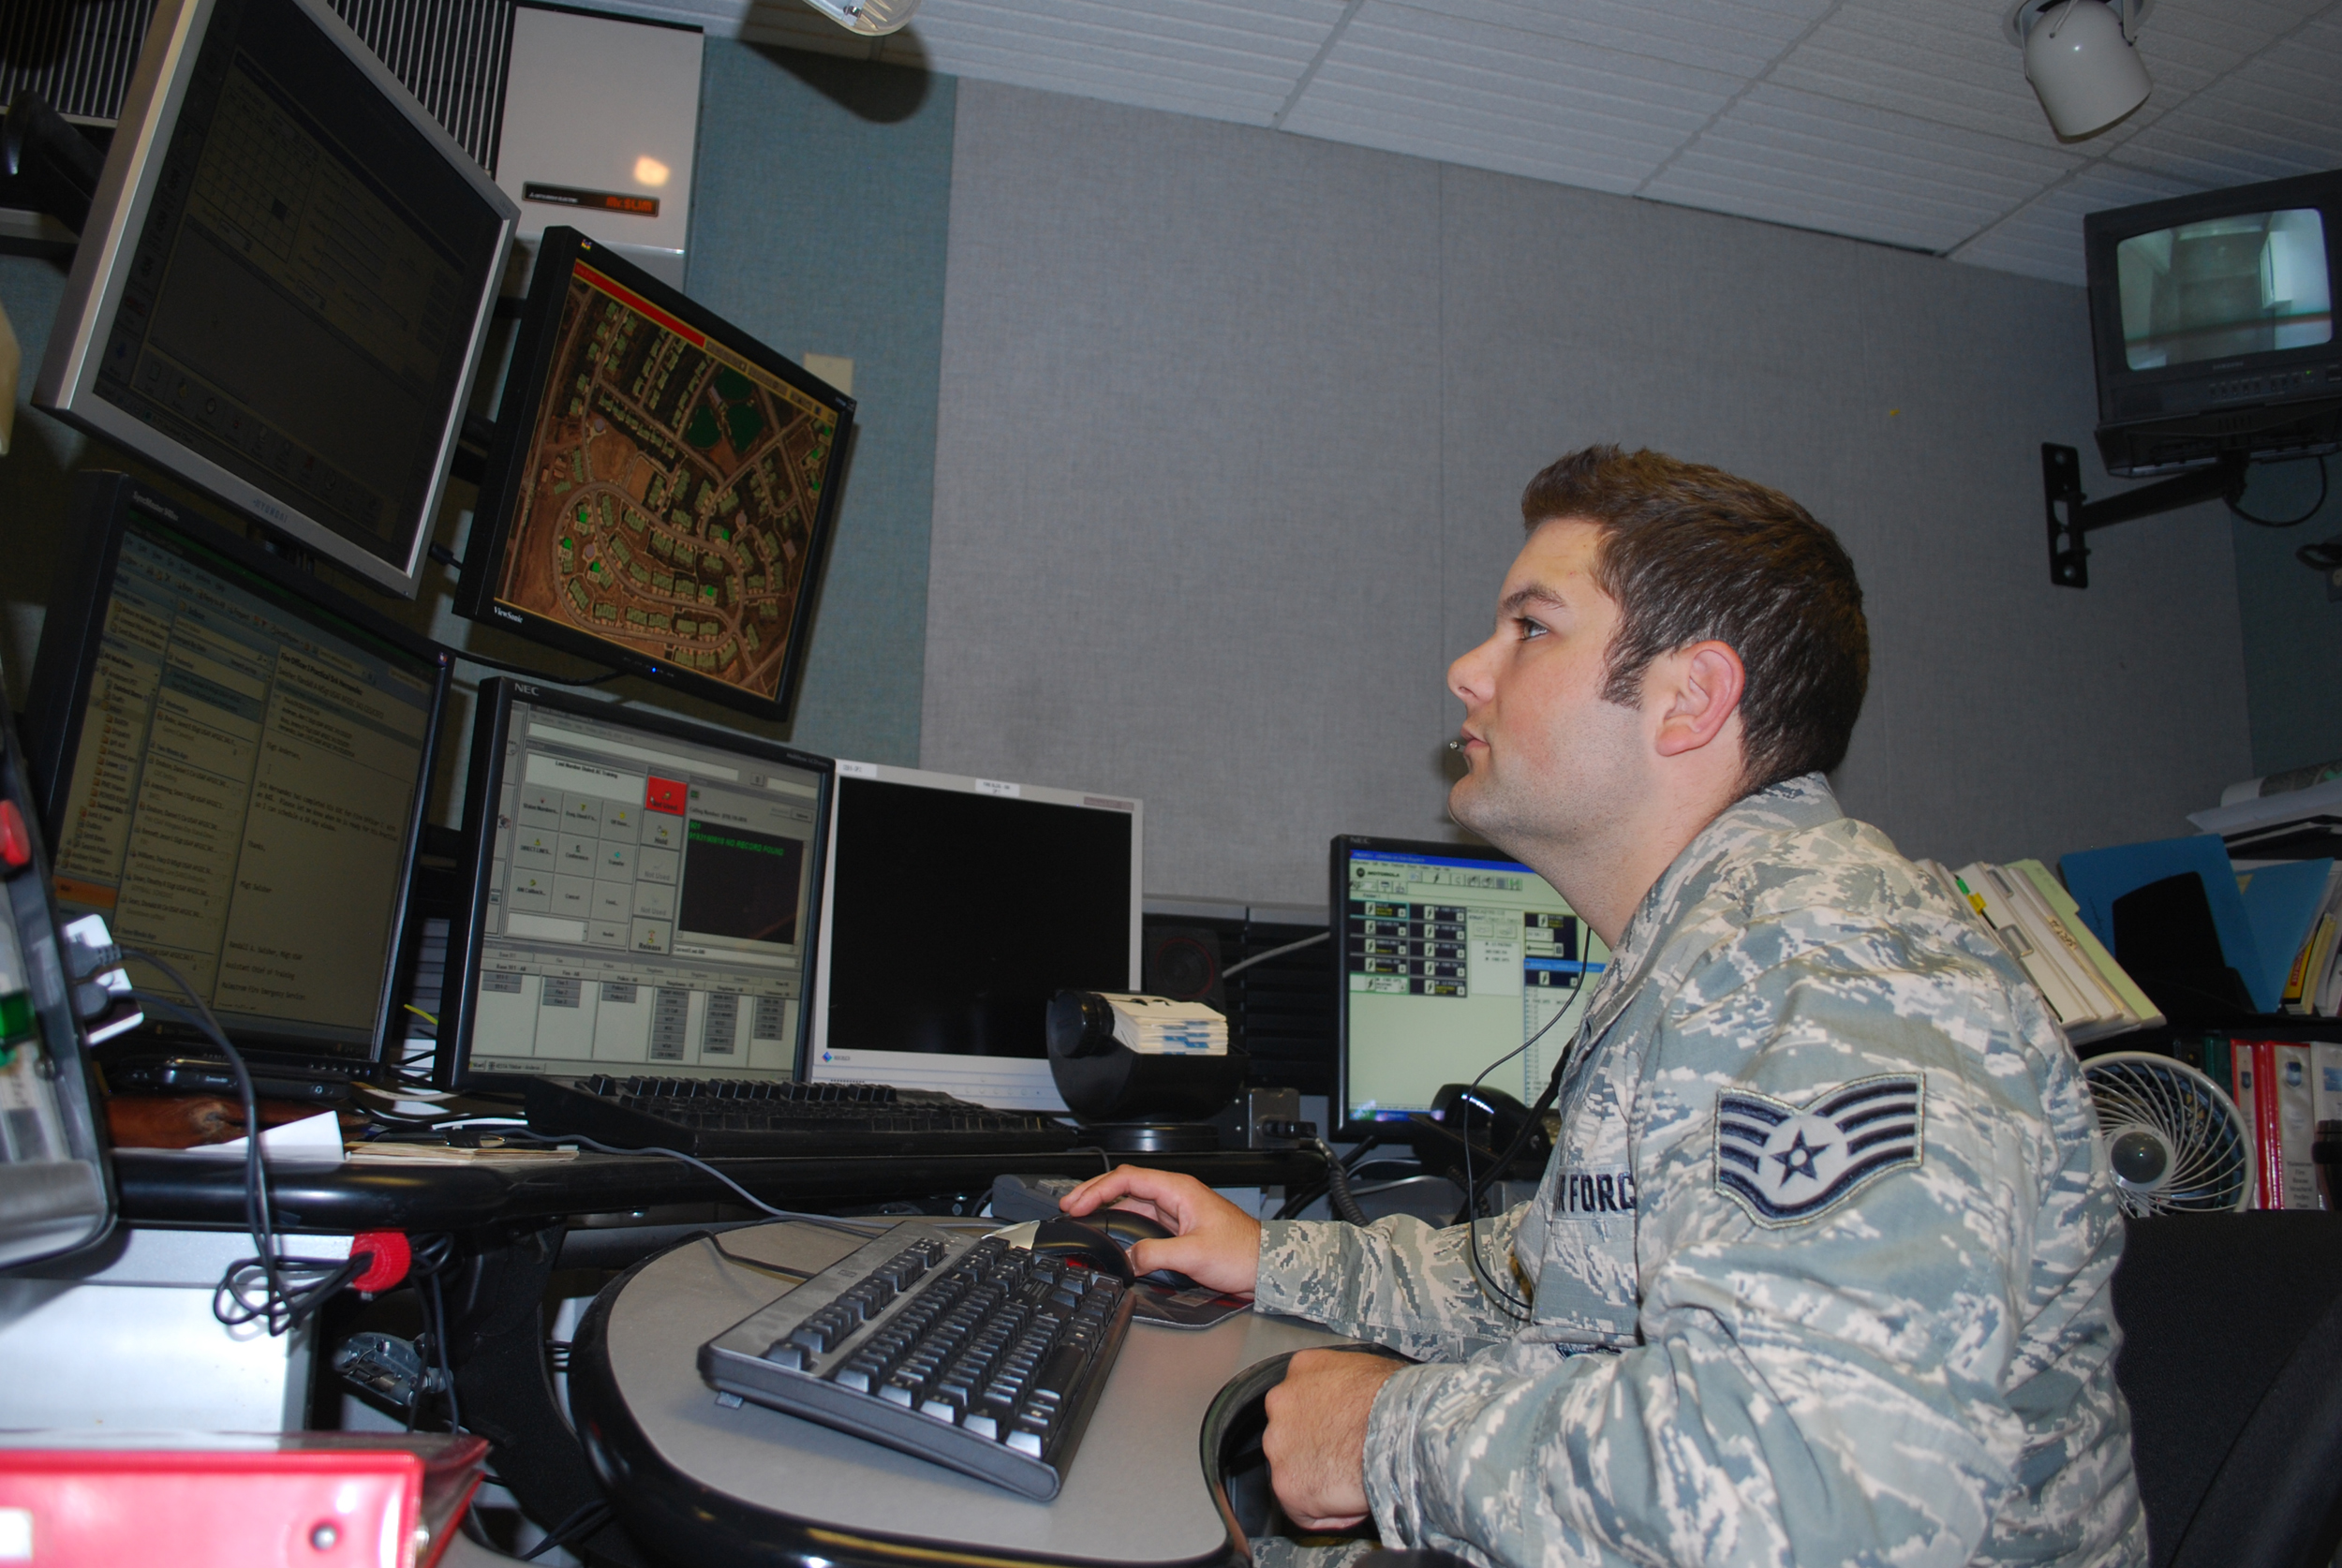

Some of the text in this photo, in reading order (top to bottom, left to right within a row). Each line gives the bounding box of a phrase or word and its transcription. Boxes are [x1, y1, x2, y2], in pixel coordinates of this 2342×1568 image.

[494, 605, 524, 625] ViewSonic
[514, 683, 540, 697] NEC
[654, 836, 668, 845] Hold
[736, 840, 762, 851] RECORD
[763, 845, 784, 856] FOUND
[656, 872, 670, 880] Used
[638, 941, 661, 952] Release
[1569, 1171, 1638, 1212] FORC
